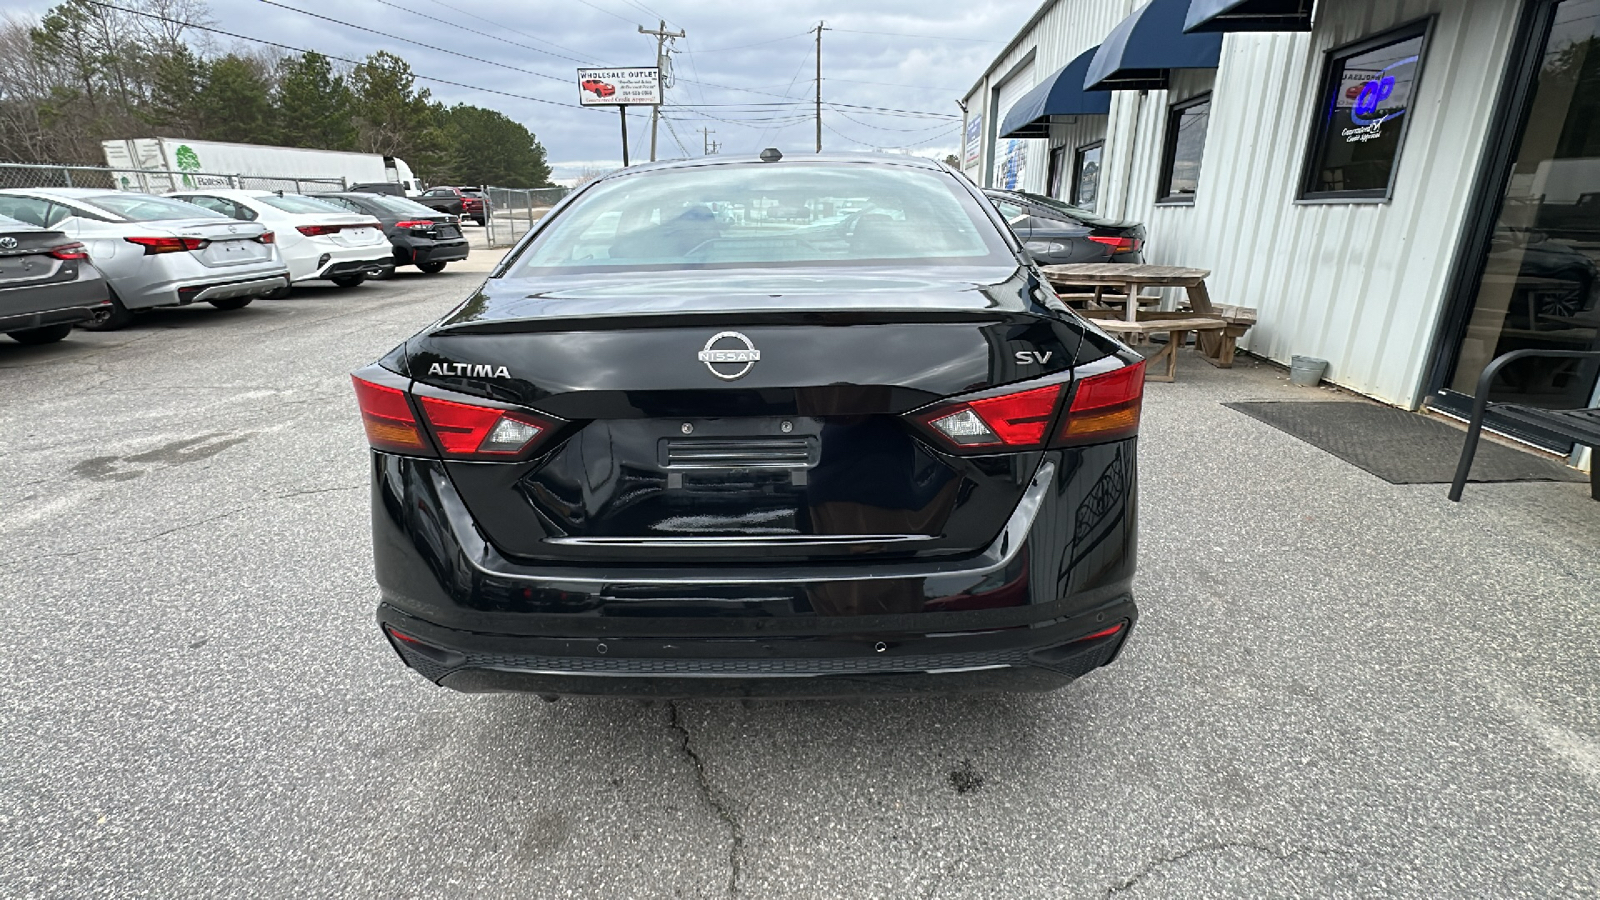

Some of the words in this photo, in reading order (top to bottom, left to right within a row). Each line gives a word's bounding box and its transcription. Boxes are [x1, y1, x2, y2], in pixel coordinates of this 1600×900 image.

[700, 352, 760, 361] NISSAN
[1015, 351, 1053, 364] SV
[427, 362, 511, 379] ALTIMA
